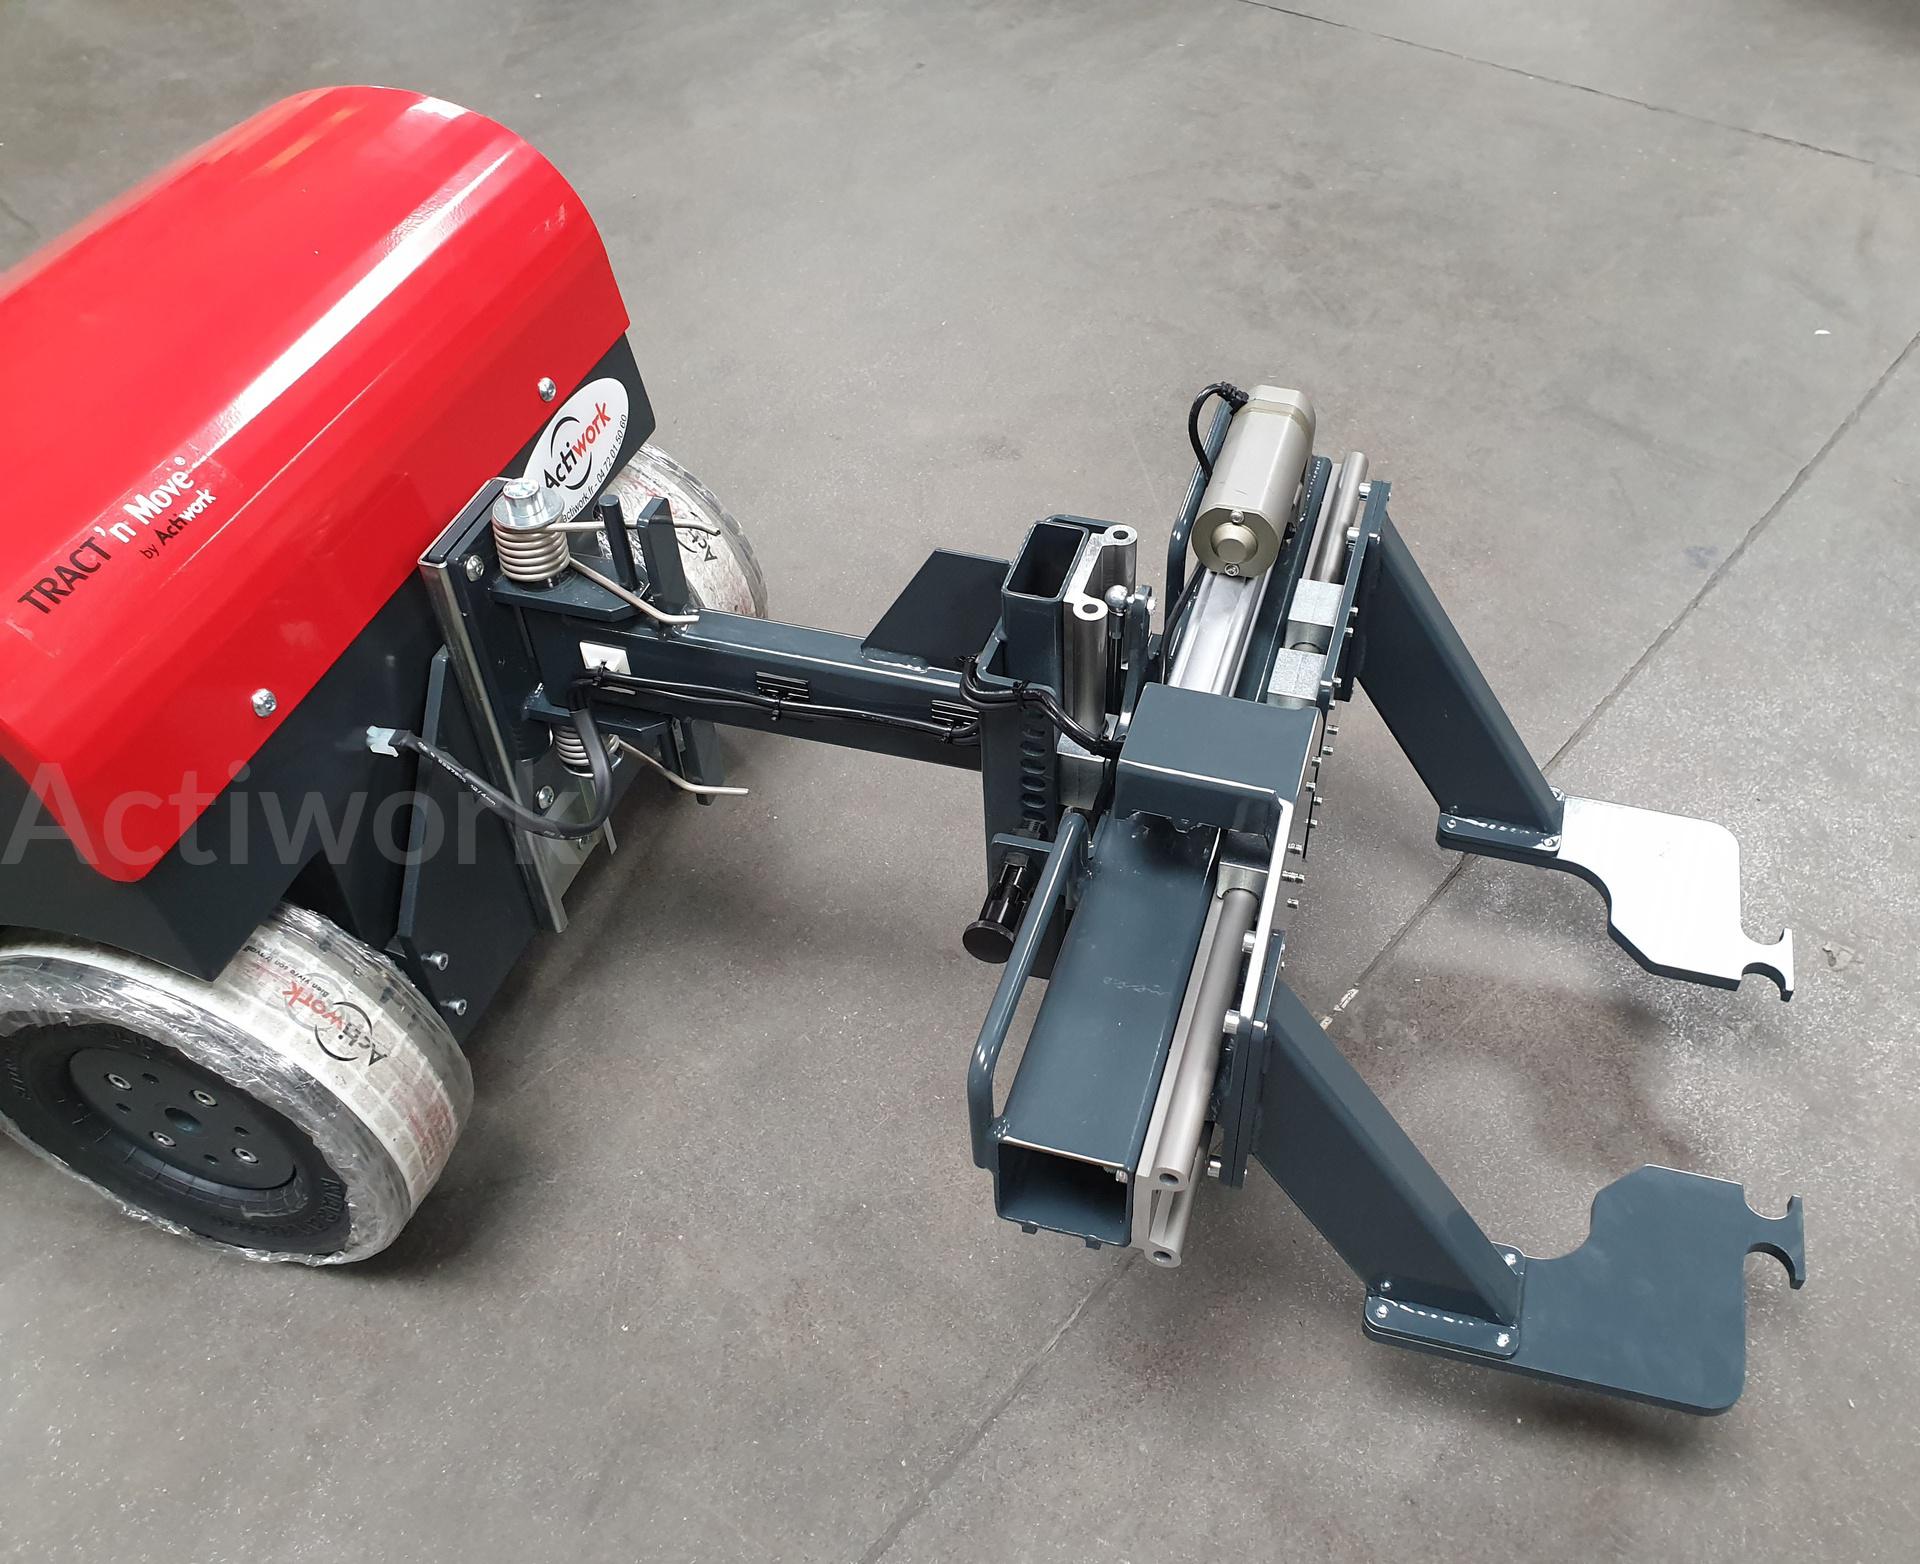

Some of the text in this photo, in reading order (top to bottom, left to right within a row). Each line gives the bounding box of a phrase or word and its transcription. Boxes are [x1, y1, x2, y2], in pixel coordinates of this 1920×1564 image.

[619, 414, 627, 429] 60
[543, 402, 611, 488] Actiwork
[616, 429, 624, 445] 50
[610, 446, 618, 459] 01
[603, 456, 613, 469] 72
[596, 469, 606, 483] 04
[140, 488, 216, 560] by Actiwork
[17, 536, 112, 614] TRACT
[282, 980, 388, 1066] Actiwork
